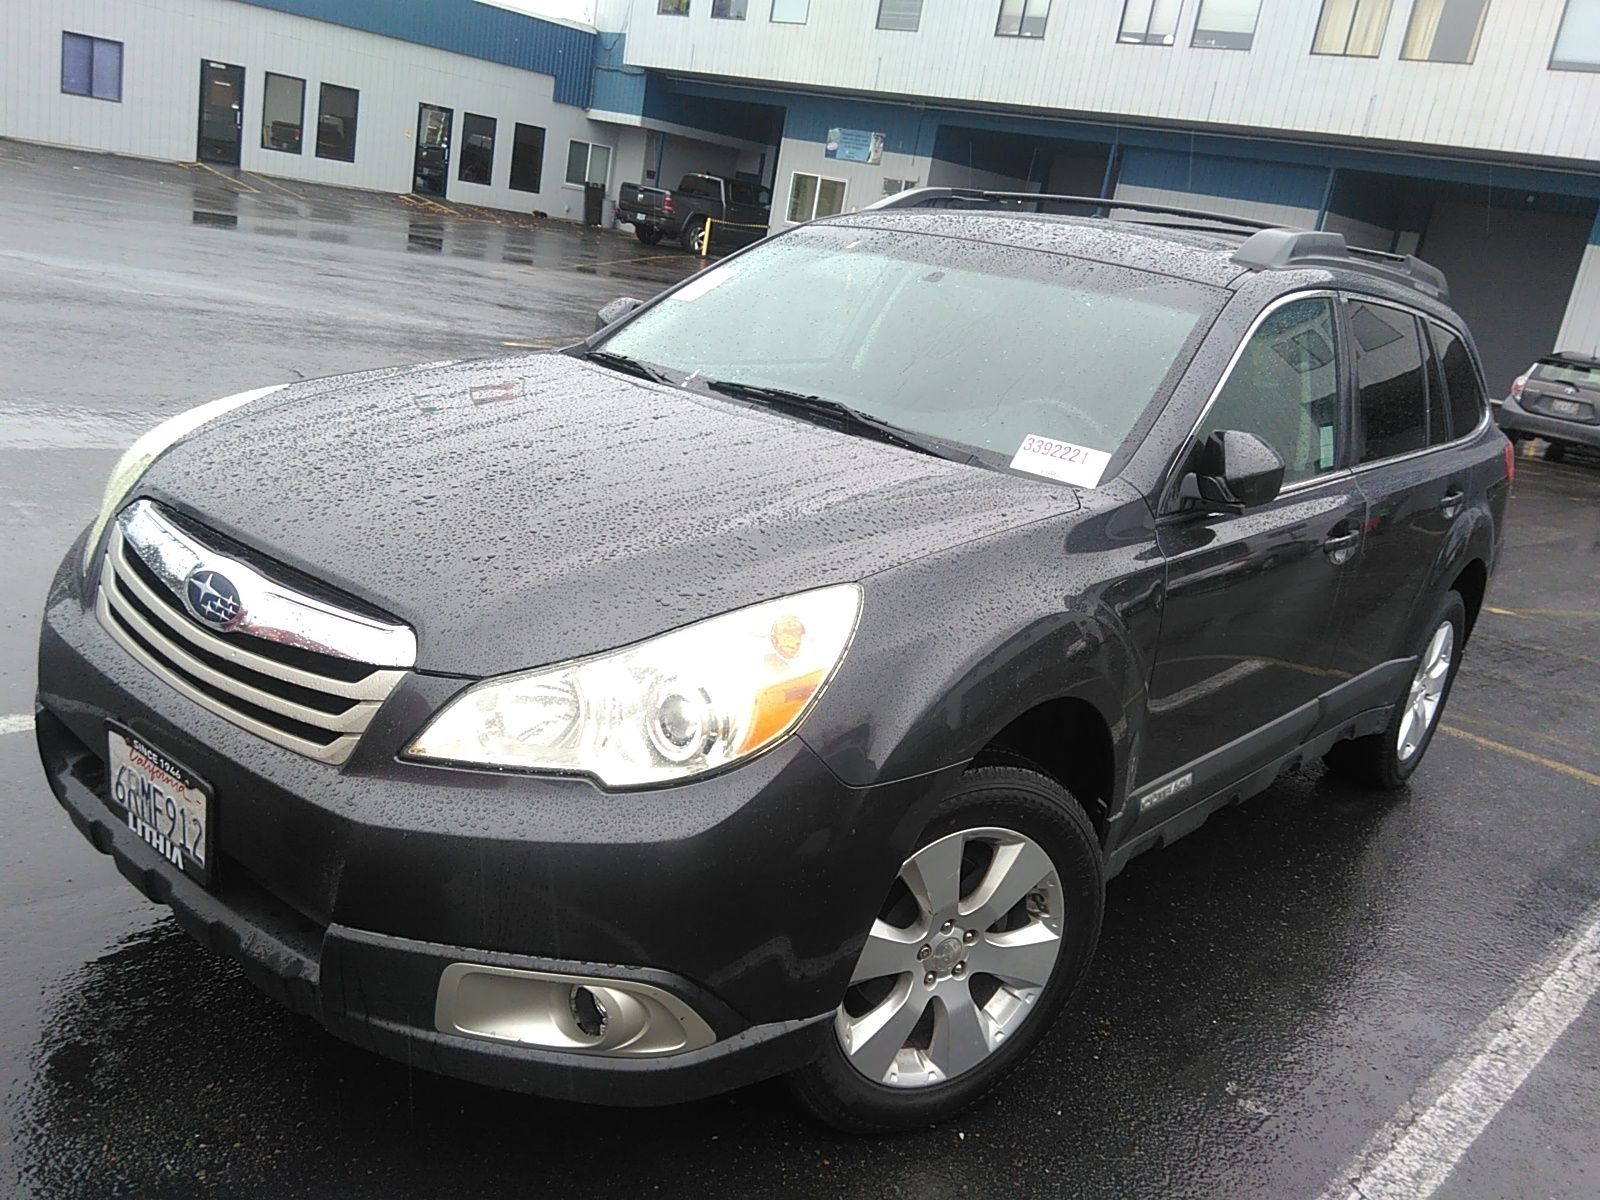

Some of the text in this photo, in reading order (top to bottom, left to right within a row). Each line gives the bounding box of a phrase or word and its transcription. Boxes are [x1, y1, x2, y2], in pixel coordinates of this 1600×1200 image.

[1023, 437, 1088, 464] 3392221
[129, 748, 191, 803] California
[132, 739, 182, 780] SINCE 1946
[115, 762, 204, 866] 6RMF912
[128, 811, 184, 871] LITHIA
